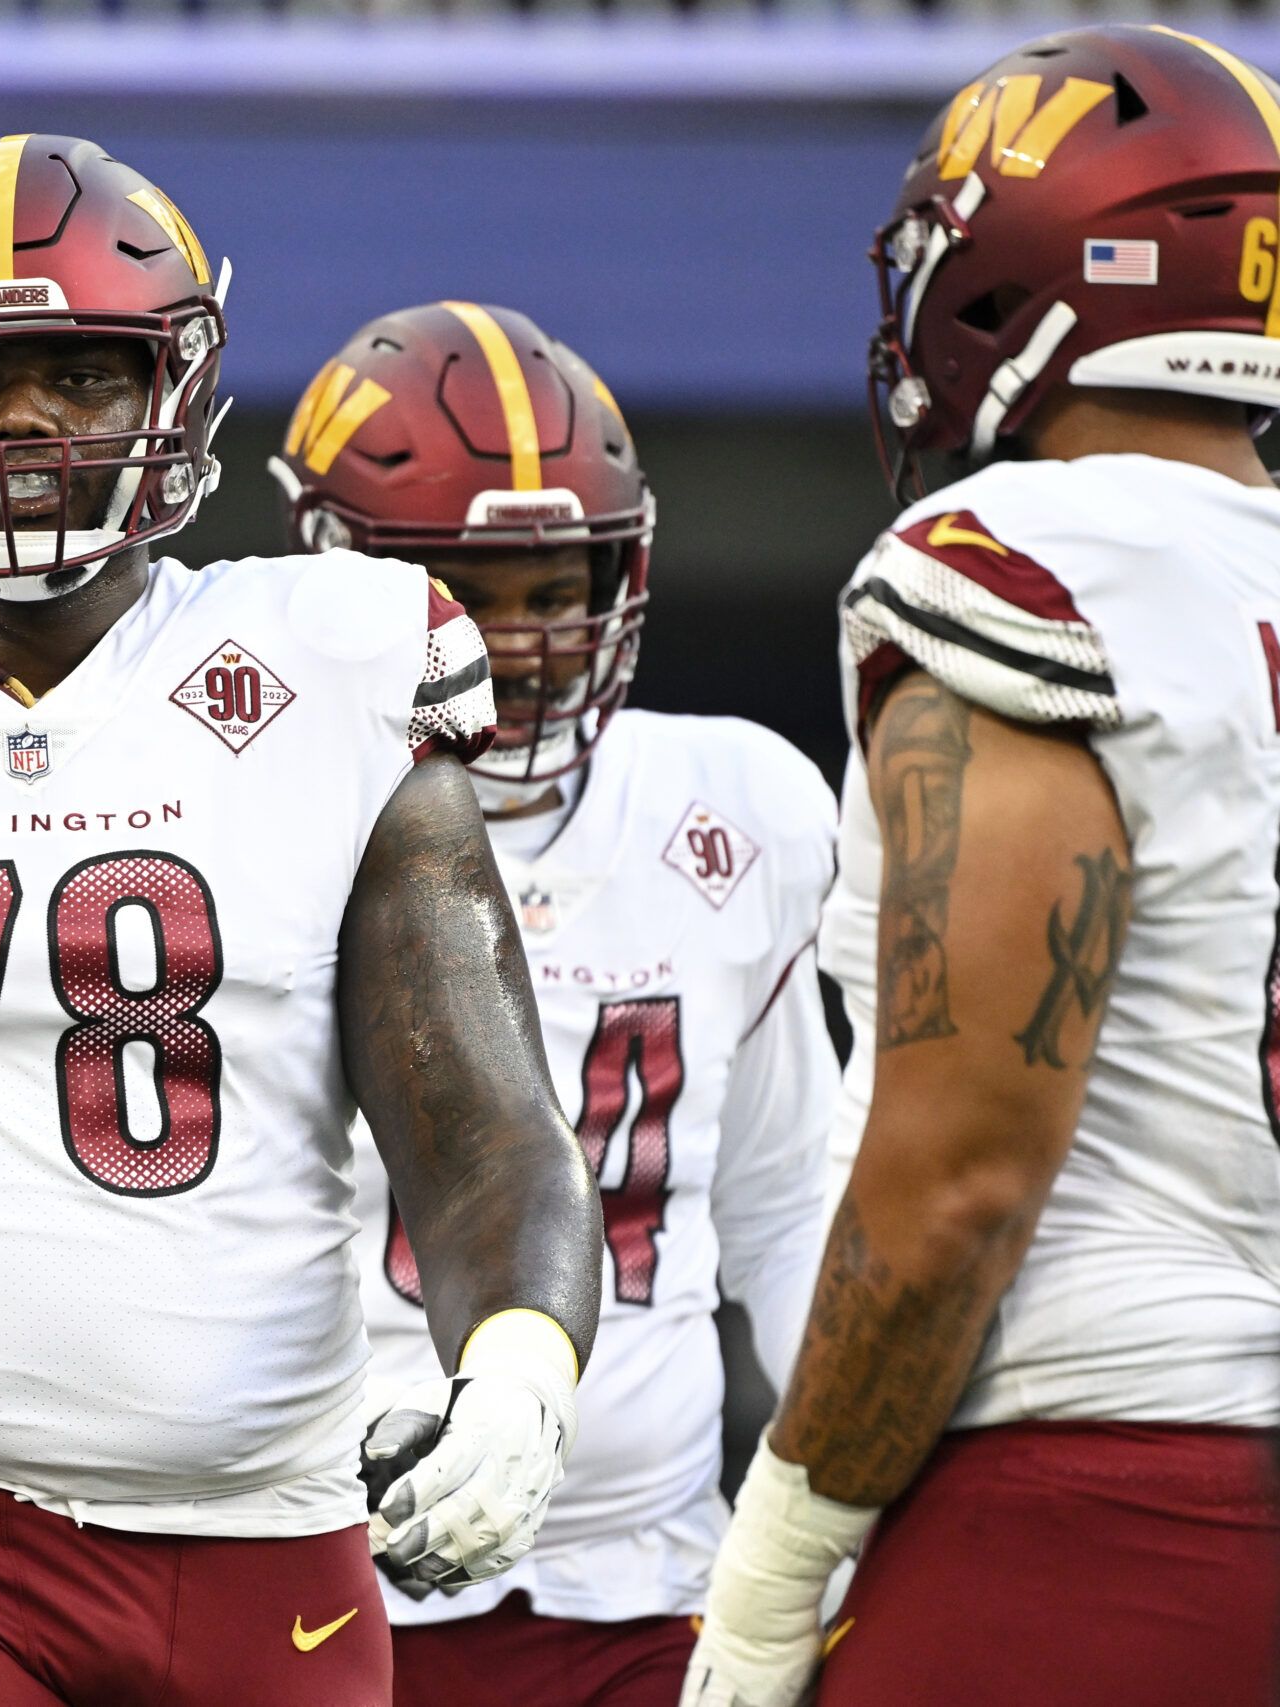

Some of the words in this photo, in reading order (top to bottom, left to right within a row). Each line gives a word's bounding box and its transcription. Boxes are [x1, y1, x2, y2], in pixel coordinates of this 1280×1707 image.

[180, 690, 204, 700] 1932
[205, 666, 262, 723] 90
[262, 690, 289, 700] 2022
[221, 724, 249, 736] YEARS
[12, 750, 46, 772] NFL
[687, 827, 733, 879] 90
[542, 957, 673, 990] NGTON
